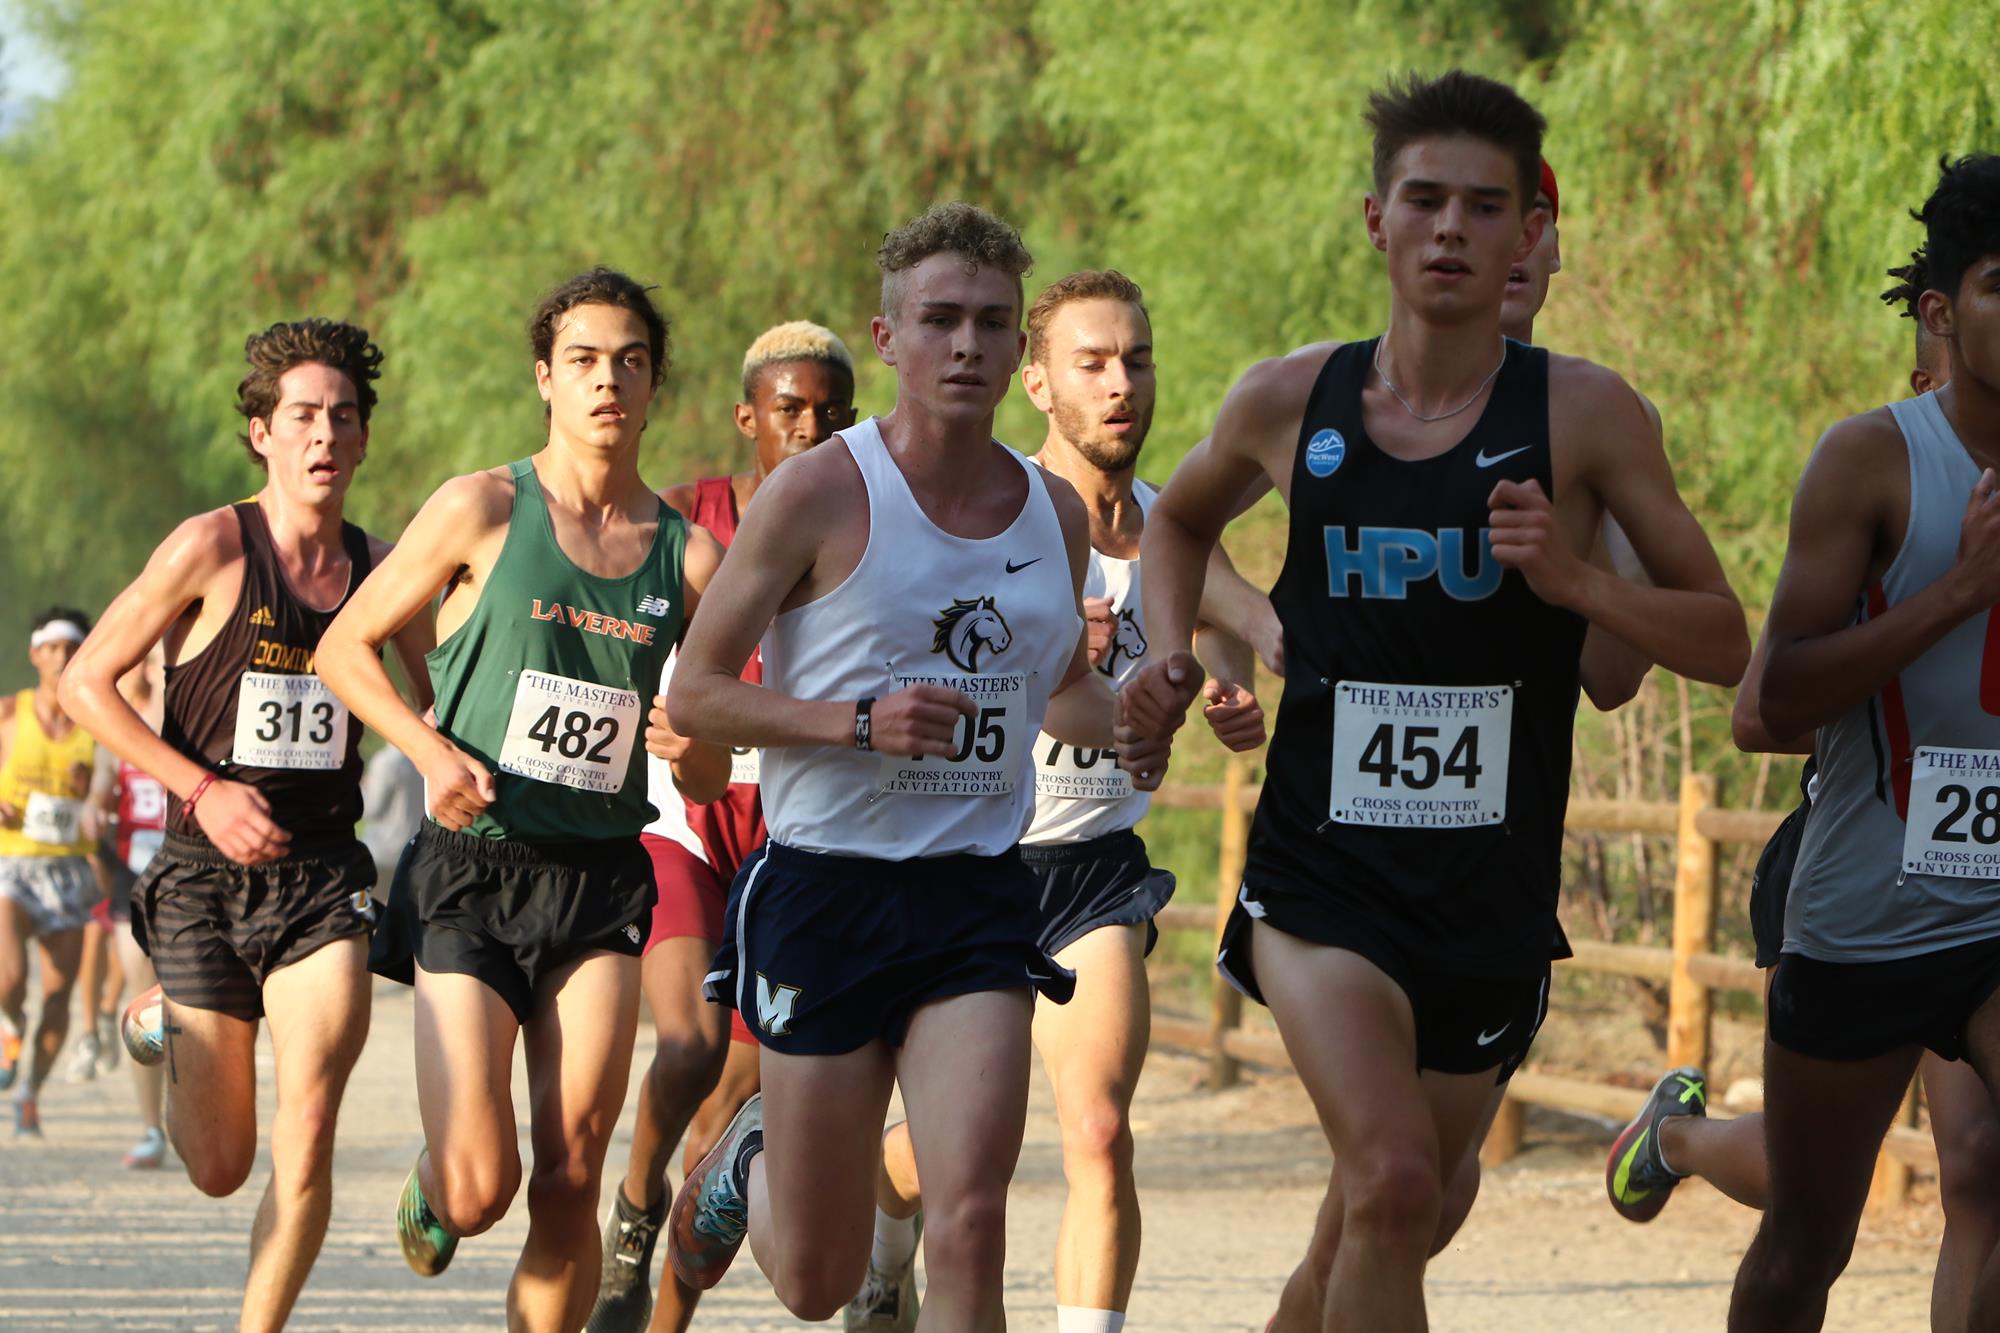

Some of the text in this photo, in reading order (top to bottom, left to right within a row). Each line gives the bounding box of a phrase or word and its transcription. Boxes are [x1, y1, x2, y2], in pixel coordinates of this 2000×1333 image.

[1323, 525, 1505, 602] HPU
[531, 598, 657, 647] LA VERNE
[253, 640, 316, 674] DOMIN
[250, 677, 281, 691] THE
[530, 675, 637, 708] THE MASTER'S
[942, 676, 1020, 693] MASTER'S
[546, 693, 617, 711] UNIVERSITY
[1348, 687, 1500, 709] THE MASTER'S
[1372, 707, 1471, 718] UNIVERSITY
[256, 700, 334, 744] 313
[527, 705, 620, 764] 482
[911, 707, 1007, 763] 05
[284, 749, 332, 759] COUNTRY
[1358, 723, 1482, 790] 454
[1927, 751, 1967, 770] THE
[517, 754, 608, 781] CROSS COUNTRY
[898, 769, 1003, 781] CROSS COUNTRY
[1949, 769, 2000, 778] UNIVER
[509, 763, 611, 791] INVITATIONAL
[1073, 776, 1124, 786] COUNTRY
[889, 780, 1008, 793] INVITATIONAL
[1035, 783, 1129, 796] NVITATIONAL
[1352, 796, 1481, 812] CROSS COUNTRY
[1344, 809, 1490, 826] INVITATIONAL
[1931, 784, 2000, 844] 28
[1924, 850, 1970, 863] CROSS
[1916, 861, 2000, 877] INVITATI
